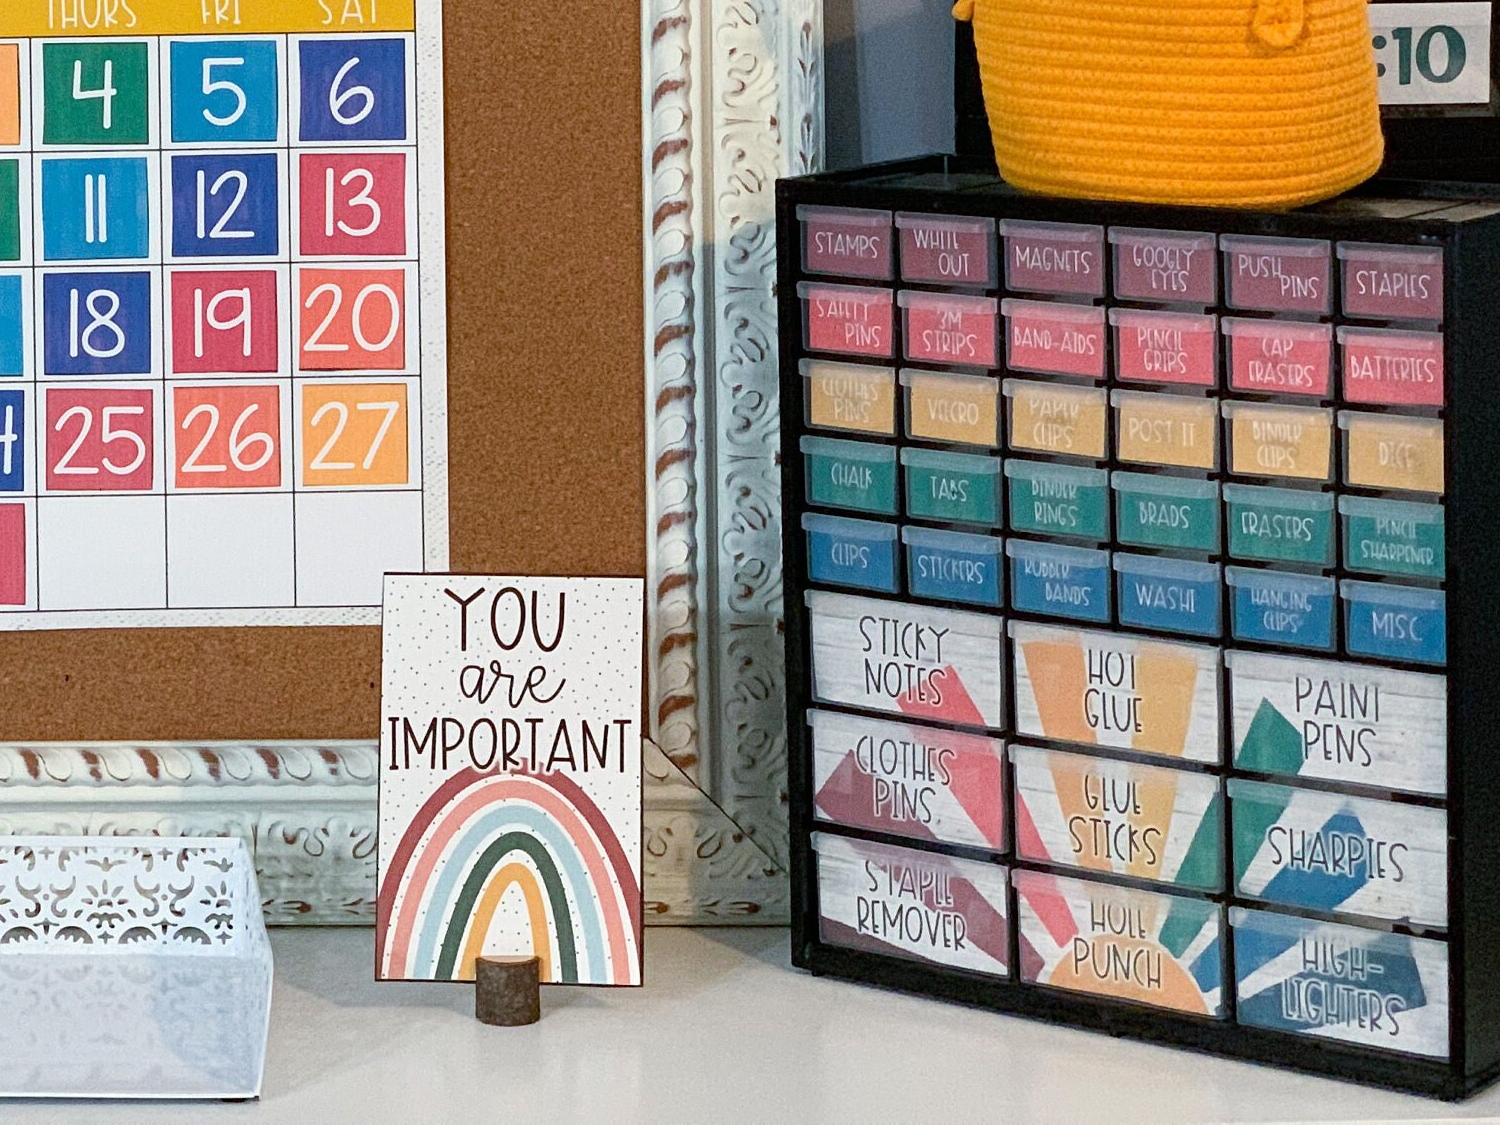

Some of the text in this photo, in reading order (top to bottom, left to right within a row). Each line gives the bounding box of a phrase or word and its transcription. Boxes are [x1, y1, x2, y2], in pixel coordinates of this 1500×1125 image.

[72, 59, 117, 129] 4
[202, 57, 246, 126] 5
[329, 57, 375, 125] 6
[84, 173, 107, 244] 11
[197, 169, 255, 239] 12
[325, 167, 381, 237] 13
[814, 231, 880, 260] STAMPS
[1015, 245, 1093, 275] MAGNETS
[1133, 245, 1195, 271] GOOGLY
[938, 252, 970, 276] OUT
[1239, 254, 1282, 278] PUSH
[1151, 269, 1189, 293] EYES
[1281, 275, 1320, 299] PINS
[1356, 270, 1431, 299] STAPLES
[70, 288, 126, 358] 18
[194, 287, 252, 358] 19
[303, 283, 400, 352] 20
[845, 323, 882, 348] PINS
[922, 329, 977, 357] STRIPS
[1014, 326, 1096, 356] BAND-AIDS
[1137, 327, 1184, 351] PENCIL
[1262, 336, 1293, 359] CAP
[1143, 349, 1188, 374] GRIPS
[1249, 360, 1315, 388] ERASERS
[1350, 355, 1437, 383] BATTERIES
[834, 399, 871, 423] PINS
[927, 399, 979, 425] VELCRO
[53, 405, 147, 475] 25
[181, 403, 275, 473] 26
[310, 400, 400, 470] 27
[1033, 421, 1075, 448] CLIPS
[1128, 418, 1173, 443] POST
[1257, 445, 1296, 469] CLIPS
[831, 461, 873, 490] CHALK
[931, 476, 969, 502] TABS
[1034, 501, 1079, 527] RINGS
[1139, 501, 1191, 529] BRADS
[1241, 511, 1314, 542] ERASERS
[831, 542, 870, 569] CLIPS
[1361, 539, 1434, 566] SHARPENER
[918, 555, 986, 585] STICKERS
[1045, 582, 1091, 607] BANDS
[1135, 582, 1196, 613] WASHI
[1251, 587, 1312, 612] HANGING
[444, 586, 566, 653] YOU
[1263, 611, 1302, 633] CLIPS
[1372, 611, 1422, 642] MISC
[859, 615, 950, 664] STICKY
[459, 659, 566, 708] are
[864, 658, 946, 706] NOTES
[1088, 650, 1137, 690] HOT
[1084, 688, 1143, 733] GLUE
[1295, 678, 1380, 722] PAINT
[388, 716, 632, 773] IMPORTANT
[1303, 720, 1378, 767] PENS
[855, 735, 955, 785] CLOTHES
[874, 777, 936, 823] PINS
[1084, 774, 1142, 815] GLUE
[1069, 816, 1162, 866] STICKS
[1268, 826, 1409, 883] SHARPIES
[865, 859, 954, 906] STAPLE
[857, 897, 966, 951] REMOVER
[1073, 937, 1162, 989] PUNCH
[1303, 937, 1384, 976] HIGH-
[1282, 982, 1406, 1036] LIGHTERS
